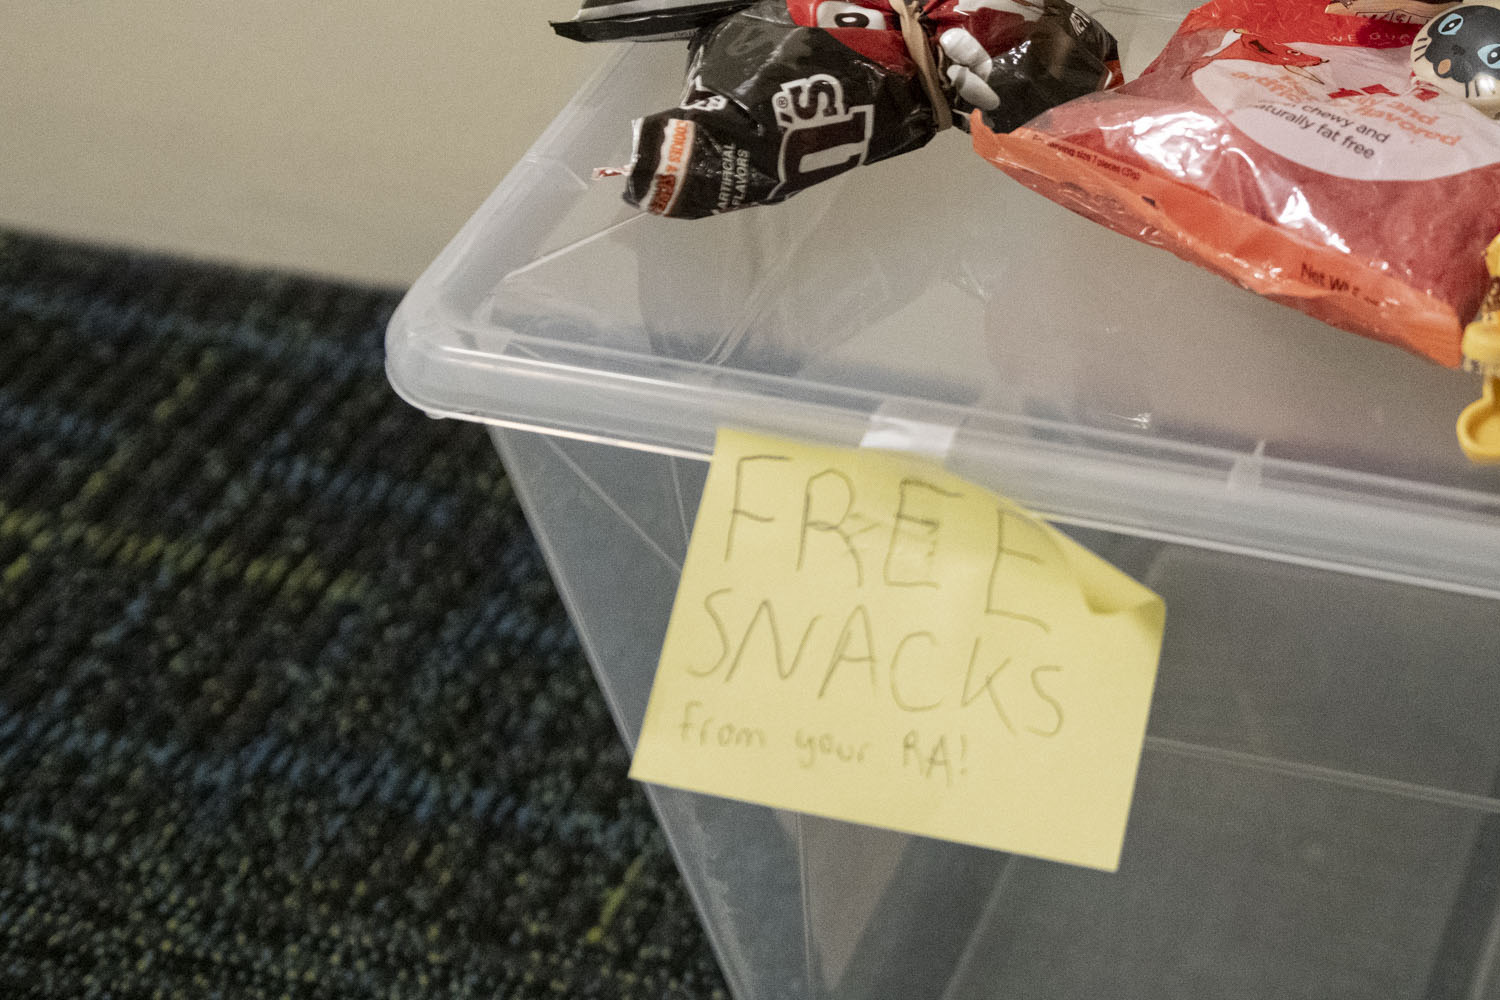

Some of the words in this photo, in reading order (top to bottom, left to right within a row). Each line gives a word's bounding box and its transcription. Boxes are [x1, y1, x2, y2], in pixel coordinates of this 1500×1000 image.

[1302, 103, 1354, 130] chewy
[1355, 123, 1391, 144] and
[1315, 122, 1341, 144] fat
[1340, 135, 1377, 161] free
[717, 143, 738, 209] ARTIFICIAL
[732, 149, 752, 207] FLAVORS
[725, 454, 1050, 633] FREE
[687, 588, 1066, 739] SNACKS
[679, 702, 766, 743] from
[795, 726, 870, 767] your
[902, 730, 969, 787] RA!
